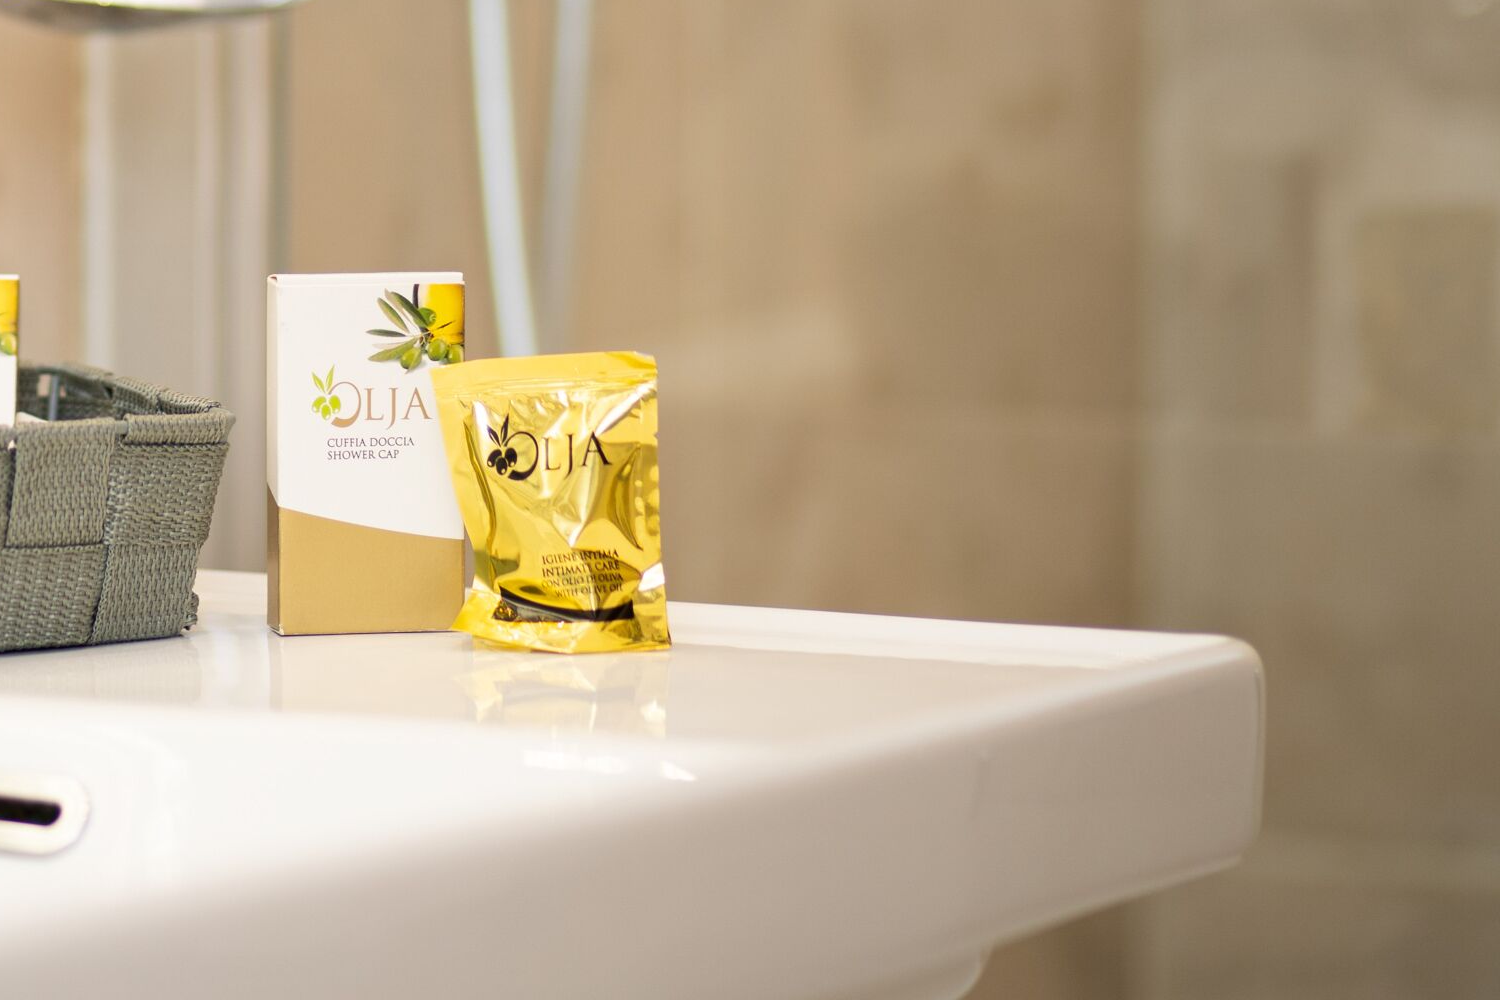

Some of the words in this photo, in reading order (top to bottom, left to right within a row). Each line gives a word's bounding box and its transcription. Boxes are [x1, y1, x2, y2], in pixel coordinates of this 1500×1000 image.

[328, 381, 433, 430] OLJA
[327, 438, 367, 448] CUFFIA
[369, 437, 415, 447] DOCCIA
[327, 450, 376, 460] SHOWER
[378, 449, 400, 459] CAP
[503, 431, 612, 480] OLJA
[541, 551, 578, 565] IGIENE
[579, 549, 619, 560] INTIMA
[541, 562, 593, 577] INTIMATE
[594, 559, 620, 571] CARE
[541, 578, 560, 588] CON
[561, 575, 585, 586] OLIO
[597, 572, 624, 583] OLIVA
[554, 587, 578, 598] WITH
